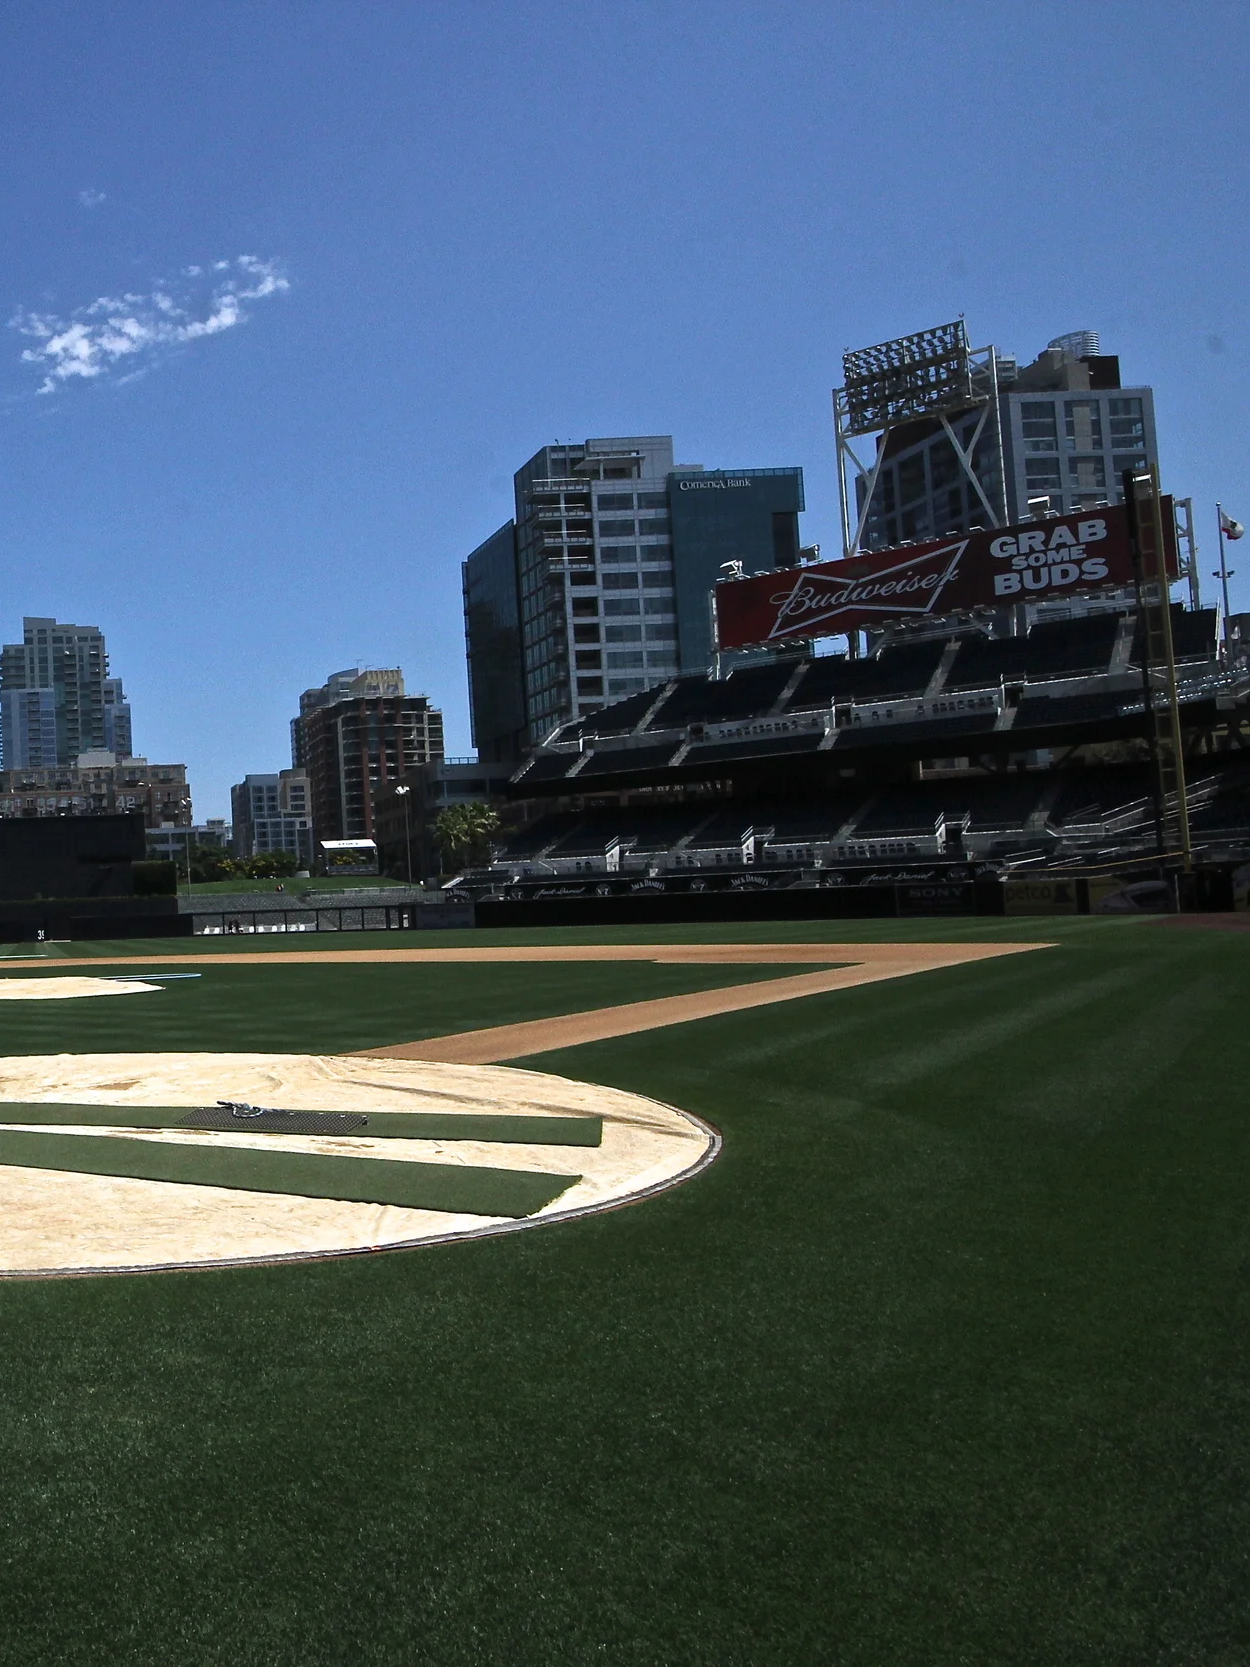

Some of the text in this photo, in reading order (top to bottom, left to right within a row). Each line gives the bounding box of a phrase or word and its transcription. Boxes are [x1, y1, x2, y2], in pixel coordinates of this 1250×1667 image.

[727, 478, 751, 487] Bank
[990, 519, 1107, 558] GRAB
[1012, 545, 1087, 570] SOME
[994, 557, 1109, 596] BUDS
[770, 569, 959, 618] Budweiser
[116, 795, 135, 808] 42
[909, 887, 963, 898] SONY
[1006, 882, 1051, 902] petco
